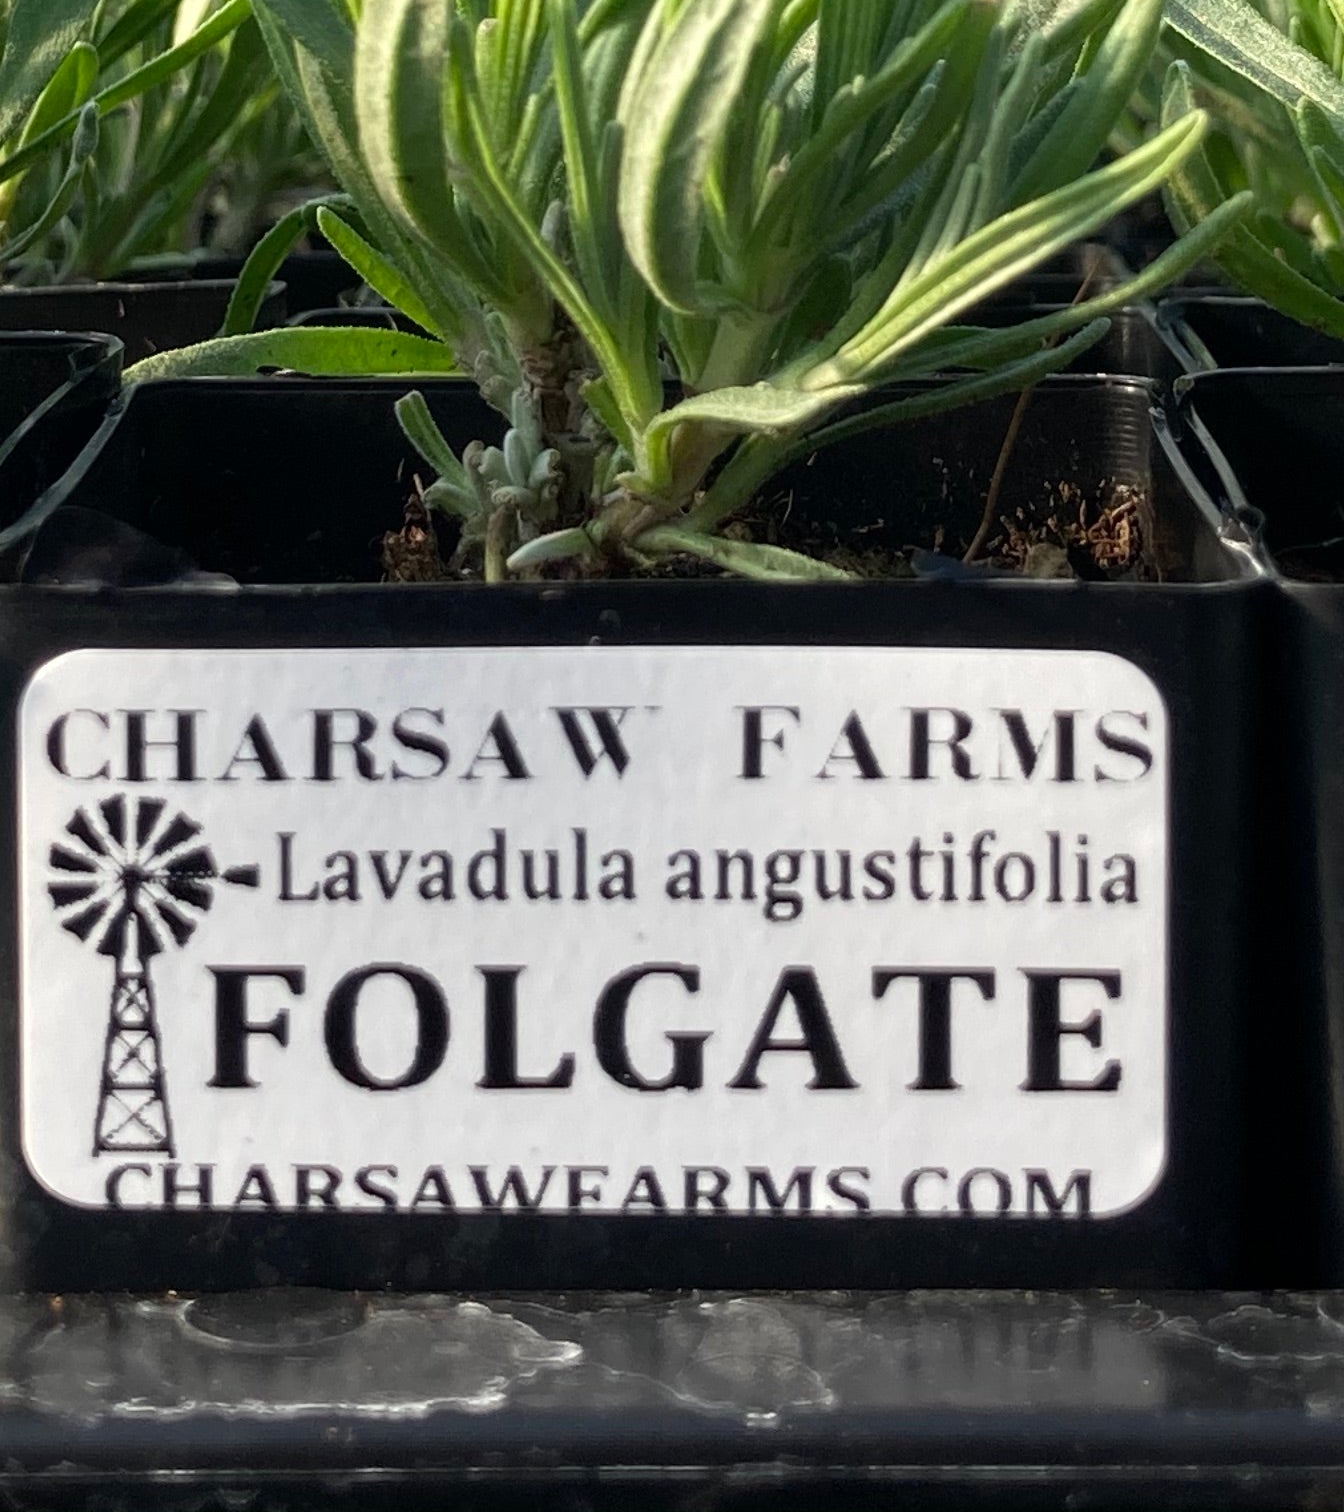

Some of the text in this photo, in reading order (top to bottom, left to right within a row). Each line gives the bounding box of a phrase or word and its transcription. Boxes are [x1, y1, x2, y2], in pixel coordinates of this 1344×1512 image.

[44, 706, 1155, 782] CHARSAW FARMS
[275, 827, 1138, 920] Lavadula angustifolia
[205, 962, 1124, 1092] FOLGATE
[104, 1162, 1094, 1213] CHARSAWFARMSCOM
